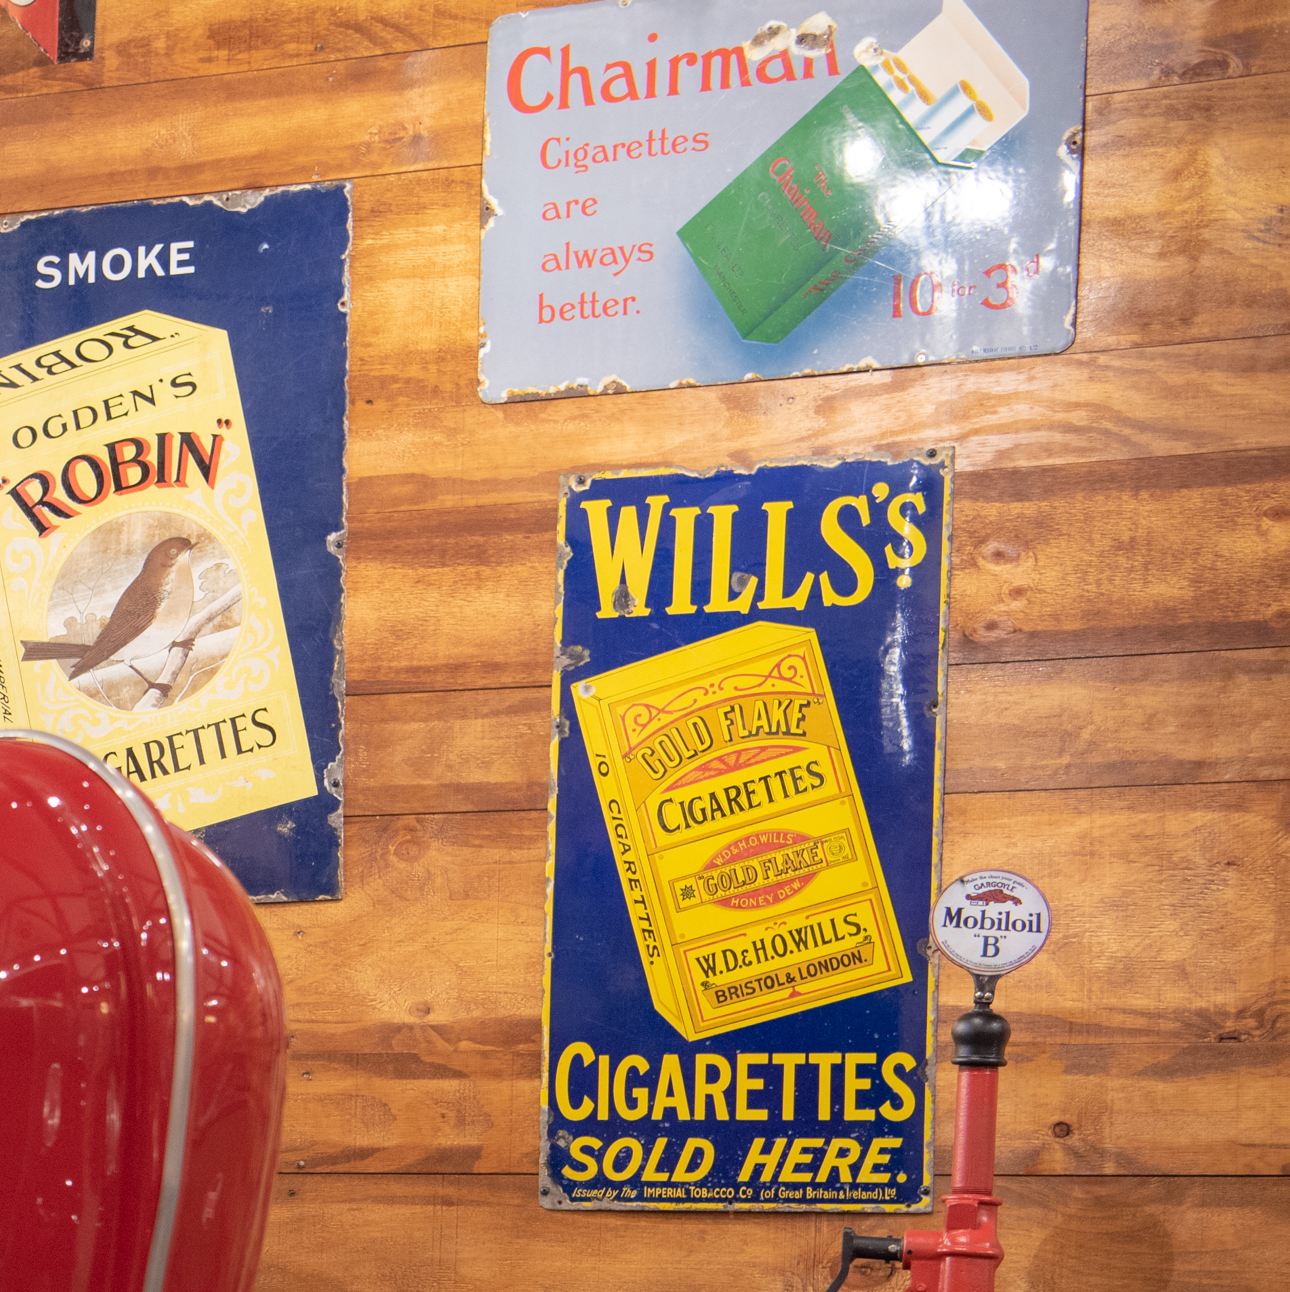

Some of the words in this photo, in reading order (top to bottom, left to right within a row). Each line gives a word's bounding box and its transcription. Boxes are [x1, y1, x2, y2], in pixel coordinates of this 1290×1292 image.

[539, 127, 711, 174] Cigarettes
[540, 194, 599, 222] are
[35, 240, 195, 289] SMOKE
[539, 241, 655, 278] always
[536, 292, 642, 325] better.
[892, 271, 942, 318] 10
[951, 280, 978, 297] for
[11, 371, 198, 450] OGDEN'S
[103, 707, 278, 783] ARETTES
[657, 761, 827, 836] CIGARETTES
[608, 798, 661, 965] CIGARETTES.
[731, 895, 774, 908] HONEY
[778, 882, 804, 899] DEW.
[973, 881, 1017, 893] GARGOYLE
[941, 906, 1043, 934] Mobiloil
[798, 950, 868, 980] LONDON.
[555, 1041, 917, 1122] CIGARETTES
[562, 1137, 715, 1183] SOLD
[739, 1137, 908, 1184] HERE.
[572, 1187, 605, 1199] Issued
[606, 1188, 619, 1200] by
[620, 1187, 638, 1199] The
[643, 1187, 687, 1198] IMPERIAL
[689, 1187, 735, 1198] TOBACCO
[760, 1187, 776, 1201] (of
[778, 1187, 804, 1199] Great
